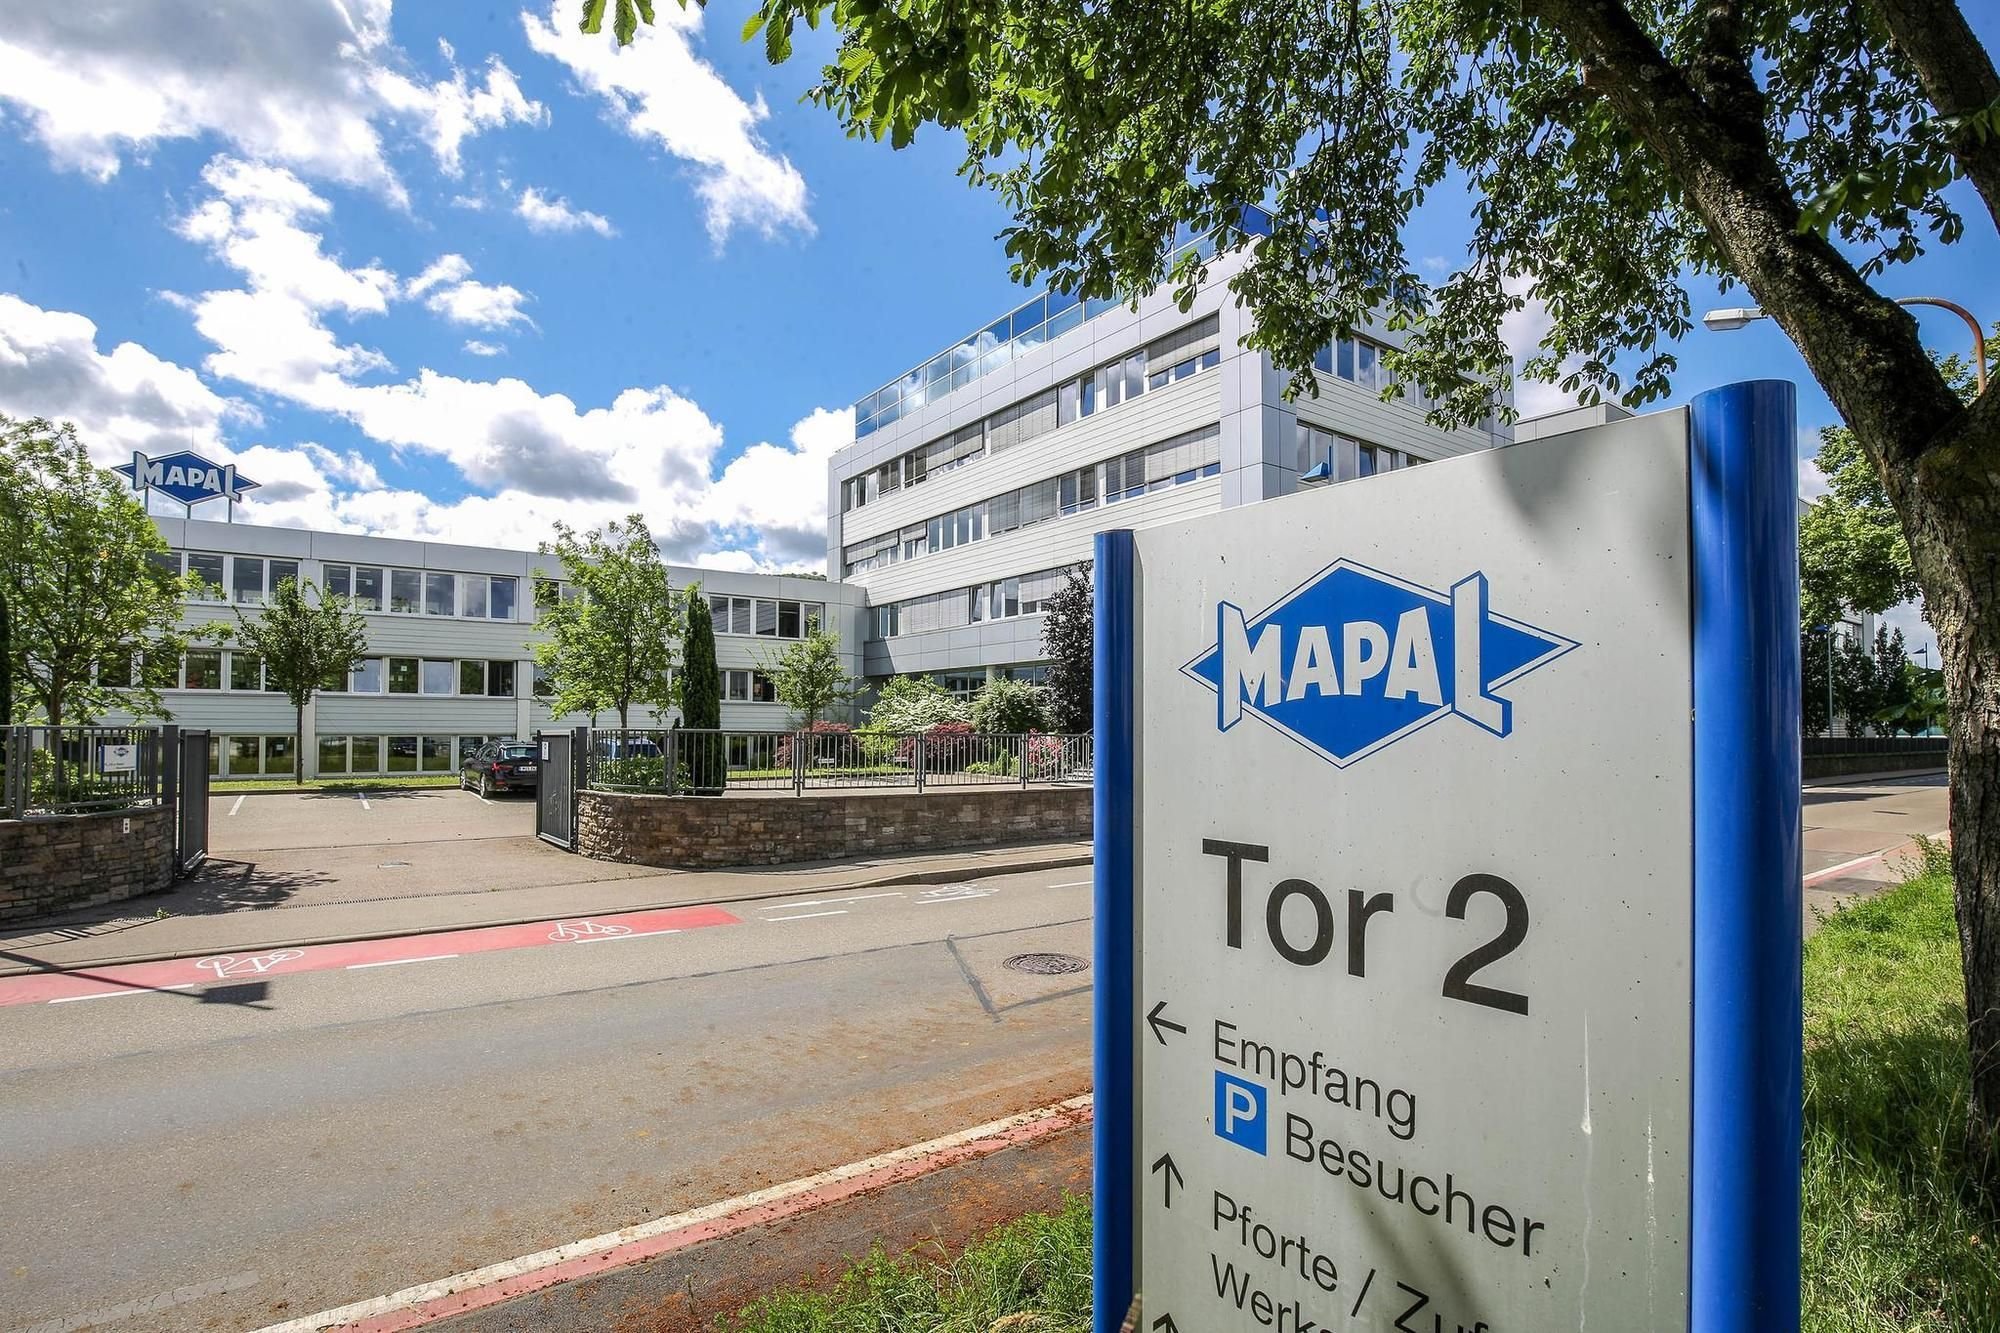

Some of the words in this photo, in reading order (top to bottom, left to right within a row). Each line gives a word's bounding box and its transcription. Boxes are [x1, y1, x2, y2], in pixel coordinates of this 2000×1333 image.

[133, 451, 241, 502] MAPAL
[1218, 571, 1512, 738] MAPAL
[1202, 838, 1394, 978] Tor
[1443, 873, 1529, 1016] 2
[1215, 1019, 1416, 1140] Empfang
[1225, 1082, 1258, 1133] P
[1286, 1113, 1545, 1257] Besucher
[1211, 1253, 1333, 1333] Werk
[1214, 1190, 1338, 1292] Pforte
[1350, 1269, 1376, 1318] /
